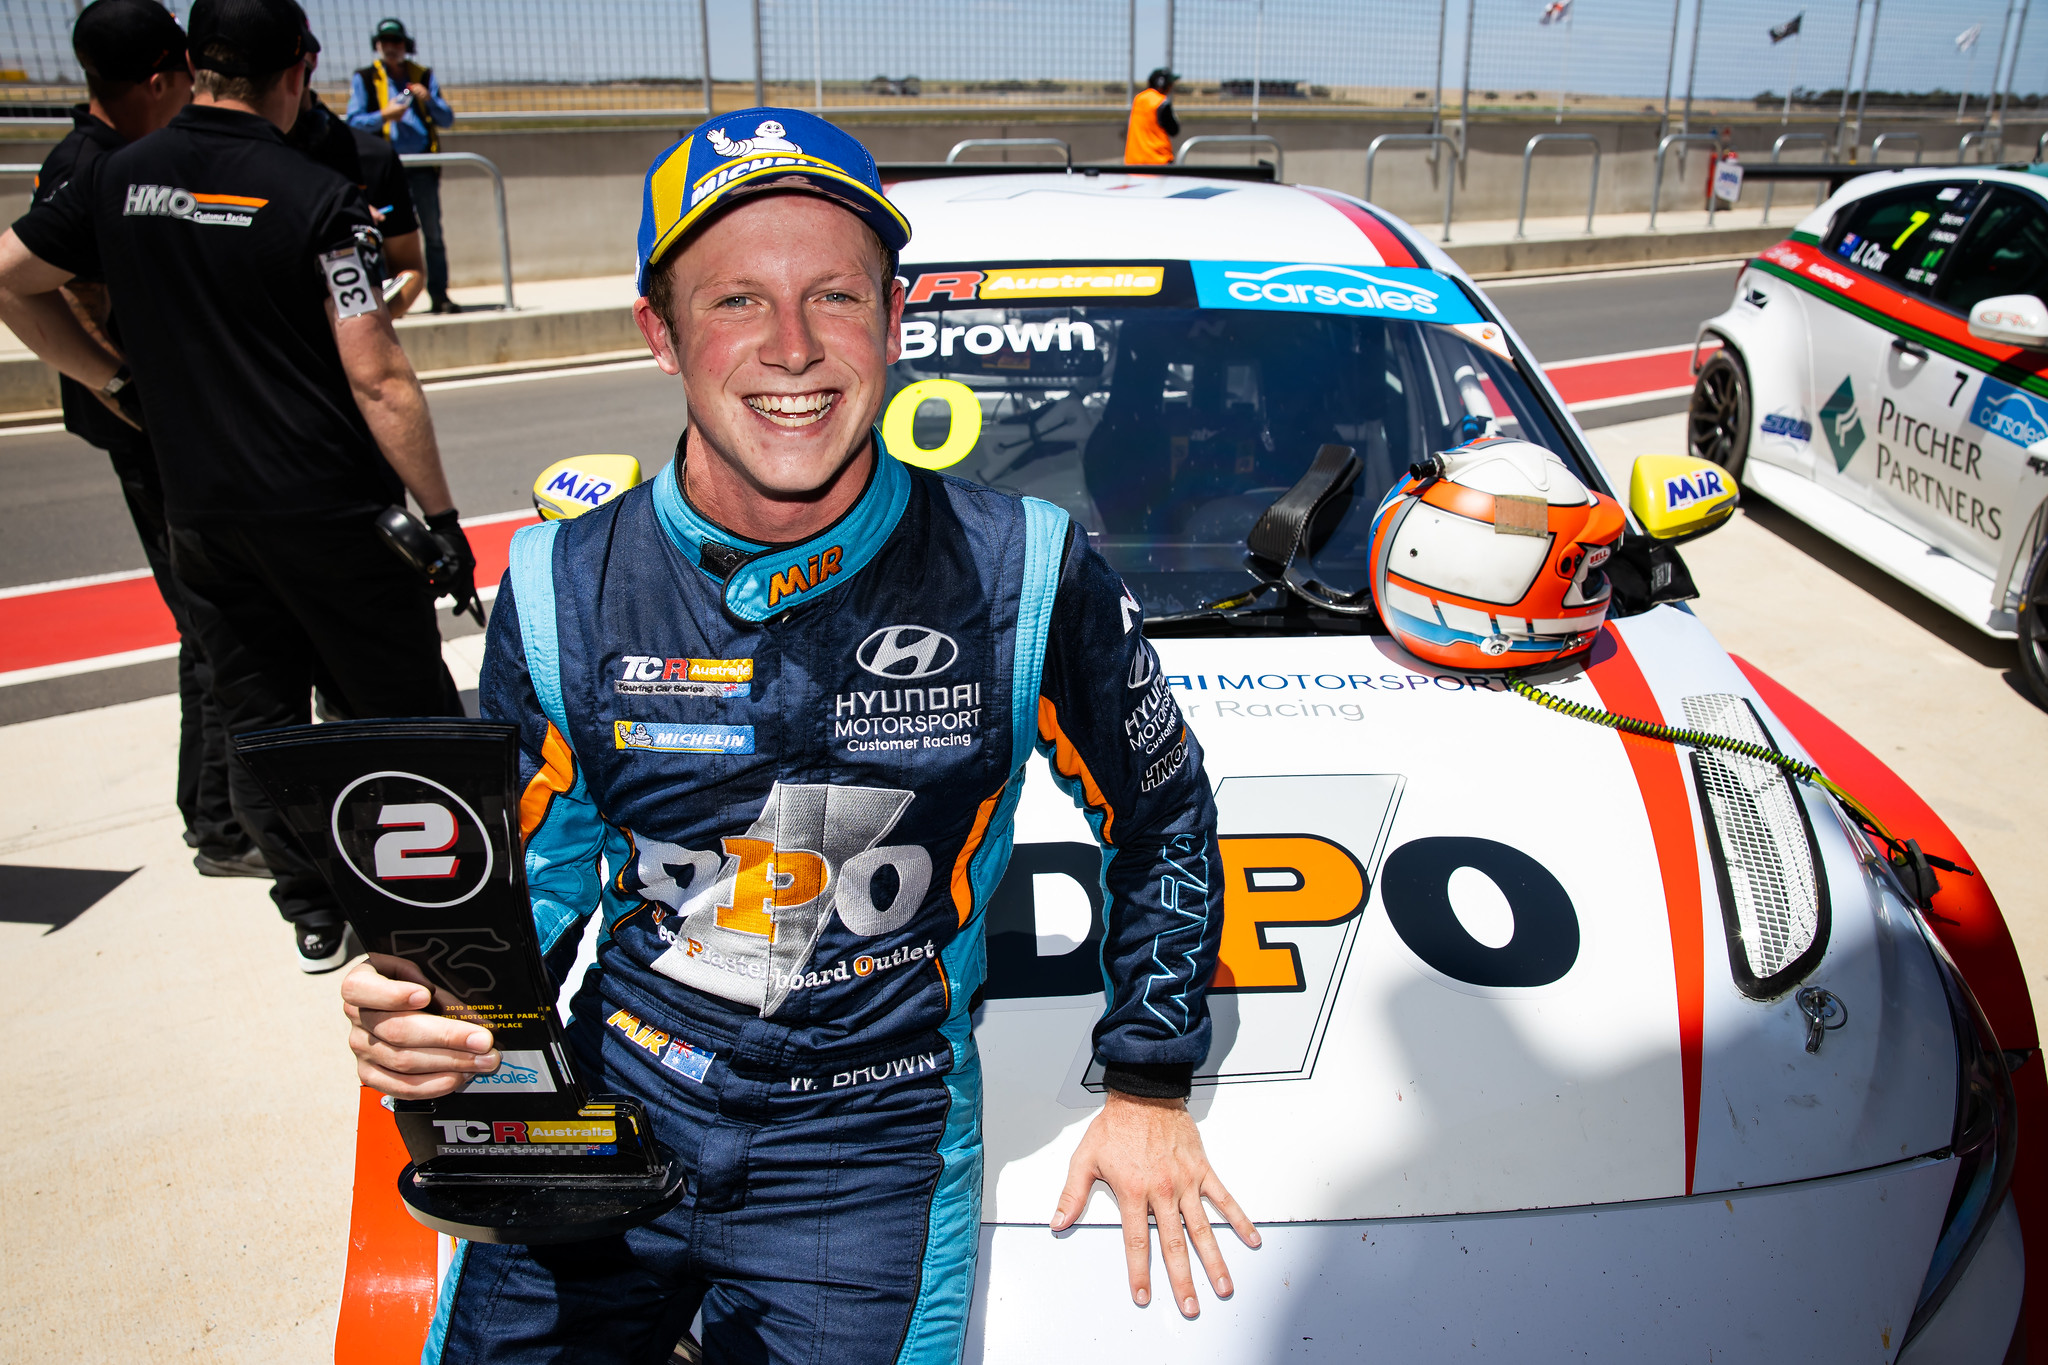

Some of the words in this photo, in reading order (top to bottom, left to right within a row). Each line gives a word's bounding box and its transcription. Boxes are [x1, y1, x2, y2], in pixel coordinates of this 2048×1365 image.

[691, 157, 824, 207] MICH
[123, 184, 198, 219] HMO
[1891, 210, 1930, 250] 7
[1861, 242, 1890, 272] Cox
[332, 266, 367, 308] 30
[988, 273, 1157, 291] Australia
[1228, 278, 1439, 316] carsales
[899, 320, 1096, 361] Brown
[1949, 370, 1969, 407] 7
[1877, 396, 1982, 481] PITCHER
[1877, 443, 2002, 540] PARTNERS
[1589, 549, 1608, 564] BELL
[621, 655, 689, 681] TCR
[1217, 674, 1515, 693] MOTORSPORT
[617, 684, 652, 694] Touring
[655, 685, 671, 693] Car
[673, 685, 704, 693] Series
[836, 682, 981, 717] HYUNDAI
[1125, 673, 1166, 736] HYUN
[835, 708, 982, 738] MOTORSPORT
[1215, 699, 1365, 722] Racing
[655, 732, 745, 747] MICHELIN
[847, 738, 919, 752] Customer
[923, 733, 971, 749] Racing
[1141, 742, 1182, 793] HMO
[374, 802, 460, 880] 2
[853, 940, 936, 978] Outlet
[832, 1051, 937, 1088] BROWN
[432, 1119, 529, 1143] TCR
[532, 1127, 613, 1137] Australia
[442, 1146, 486, 1155] Touring
